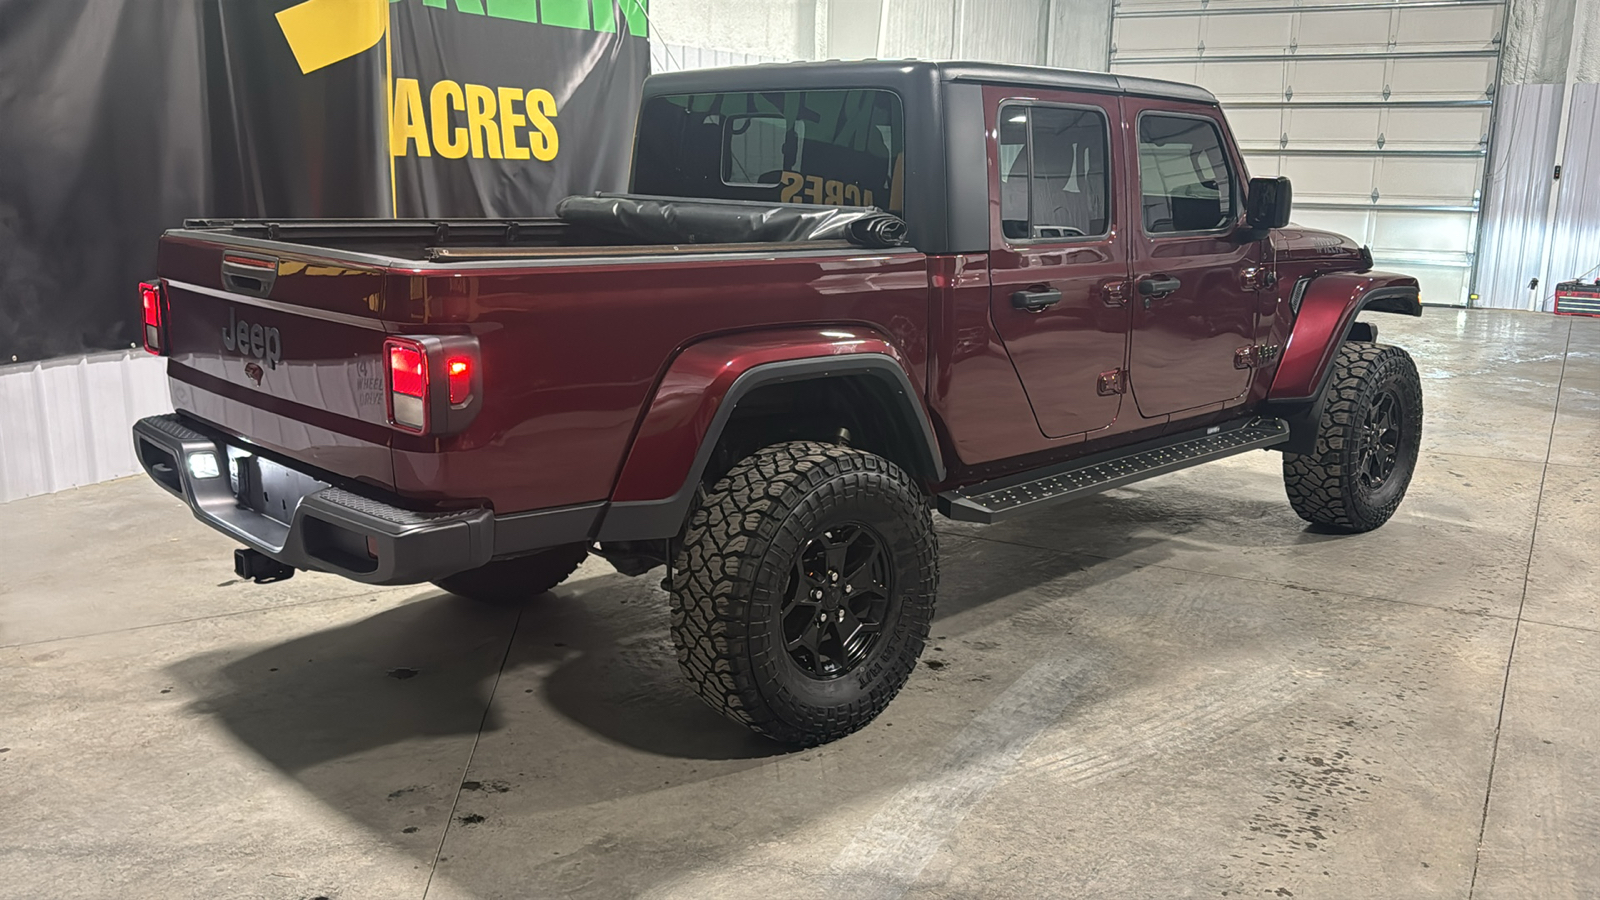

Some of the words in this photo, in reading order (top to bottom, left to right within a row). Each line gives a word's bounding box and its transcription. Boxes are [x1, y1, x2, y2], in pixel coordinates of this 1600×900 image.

[392, 77, 559, 162] ACRES
[222, 306, 281, 371] Jeep
[356, 378, 384, 391] WHEEL
[360, 392, 384, 406] DRIVE
